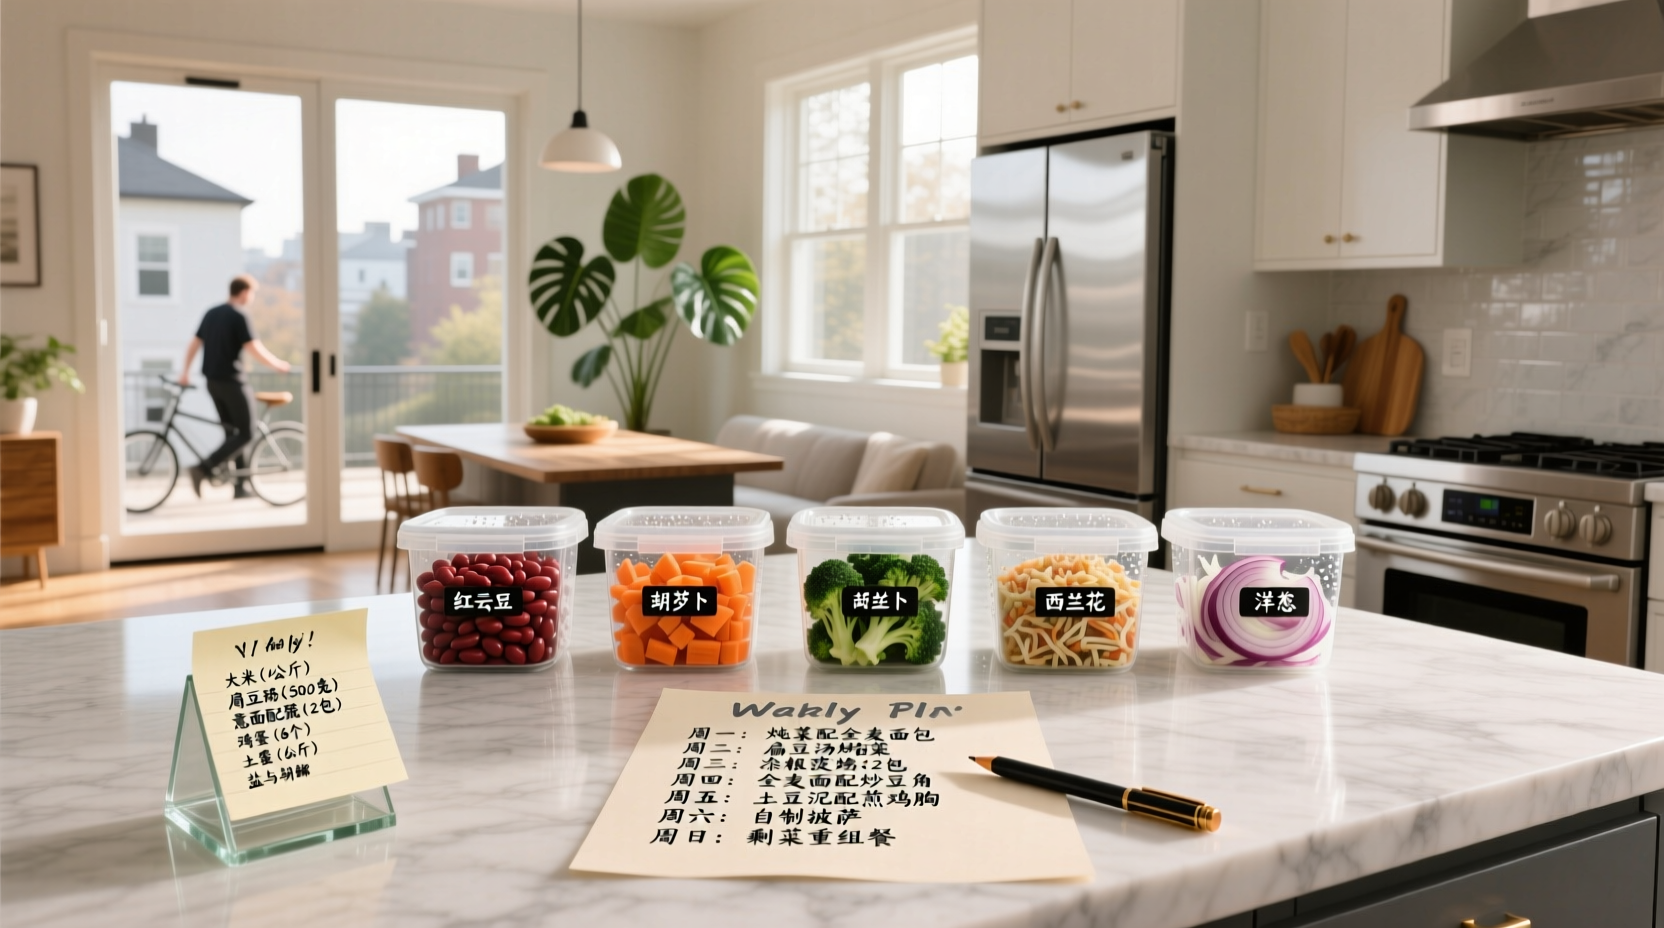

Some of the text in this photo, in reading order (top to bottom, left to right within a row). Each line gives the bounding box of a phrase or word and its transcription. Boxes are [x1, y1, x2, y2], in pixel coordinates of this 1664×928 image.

[453, 591, 513, 612] 红云豆
[650, 590, 707, 612] 胡萝卜
[1045, 591, 1106, 613] 西兰花
[688, 726, 747, 740] 周一：
[682, 741, 742, 755] 周二：
[677, 757, 738, 771] 周三：
[664, 789, 940, 807] 周五： 土豆泥配煎鸡胸
[658, 807, 862, 825] 周六： 自制披萨
[649, 827, 896, 846] 周日： 剩菜重组餐
